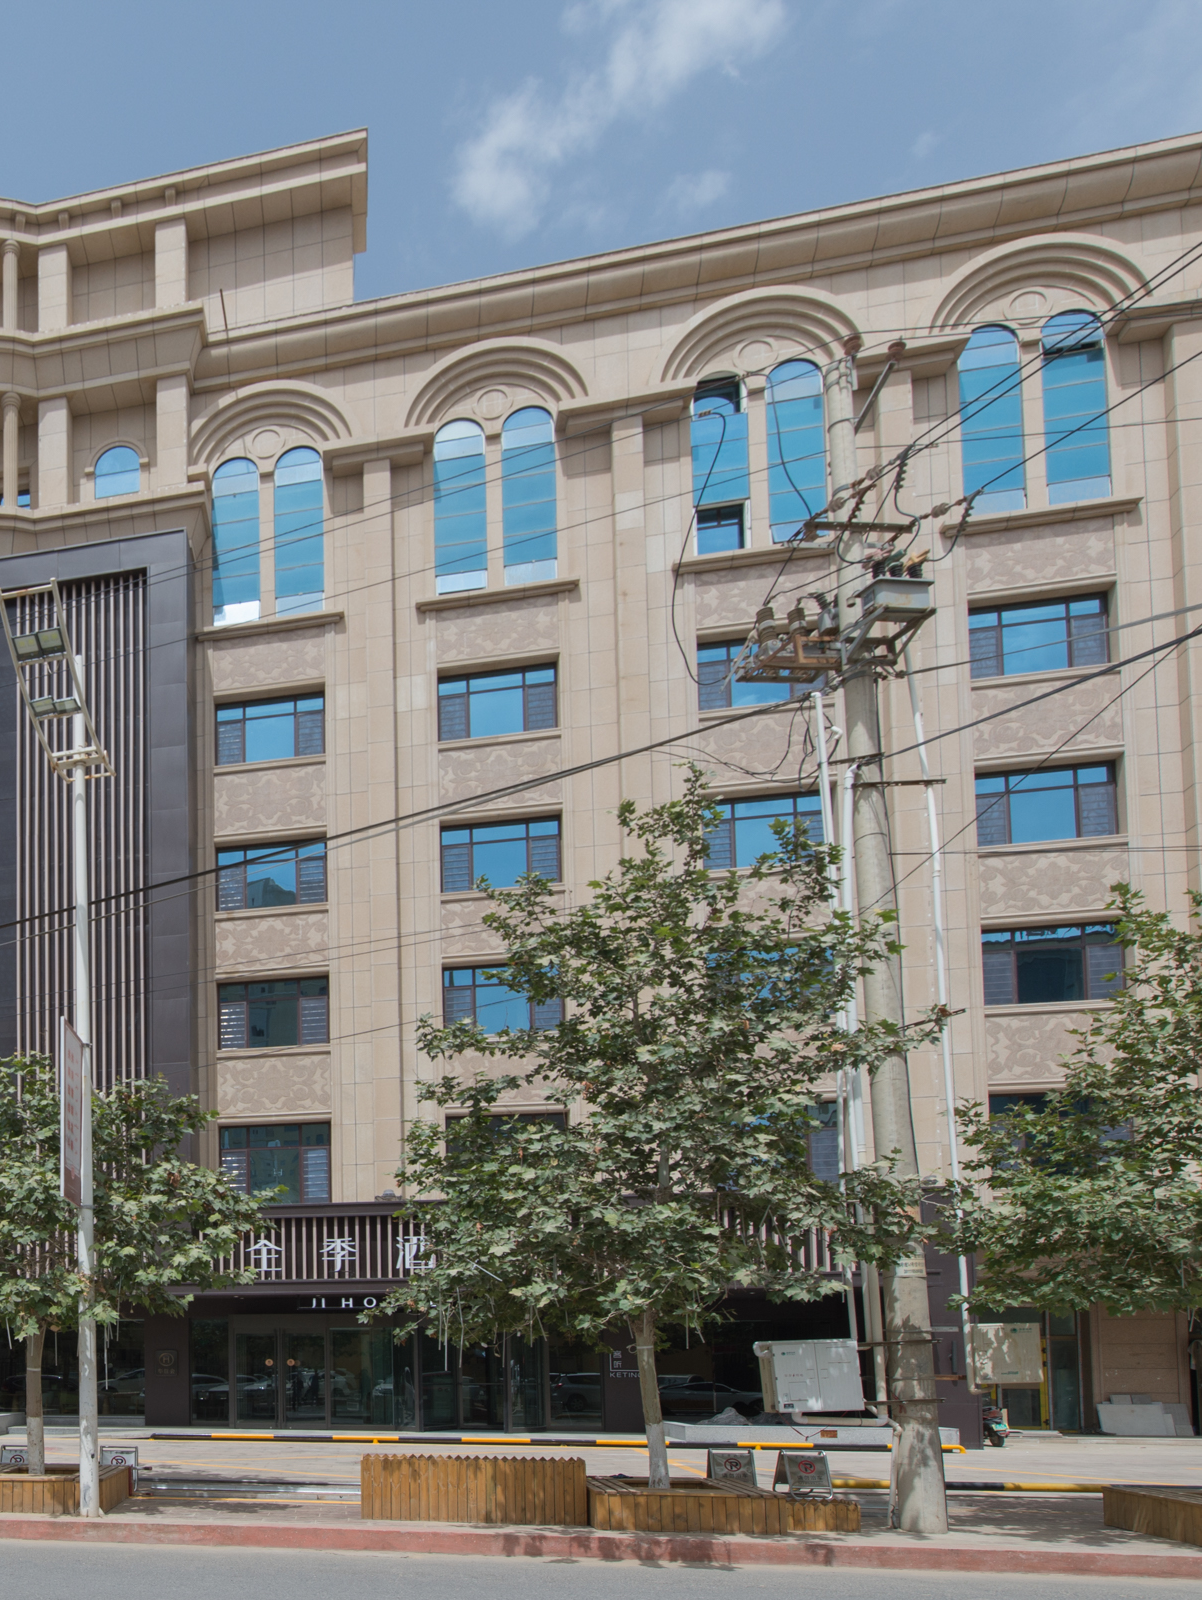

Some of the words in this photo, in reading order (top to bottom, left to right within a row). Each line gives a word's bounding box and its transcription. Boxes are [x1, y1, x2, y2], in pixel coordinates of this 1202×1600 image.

[245, 1236, 439, 1272] 全季酒
[311, 1298, 326, 1308] JI
